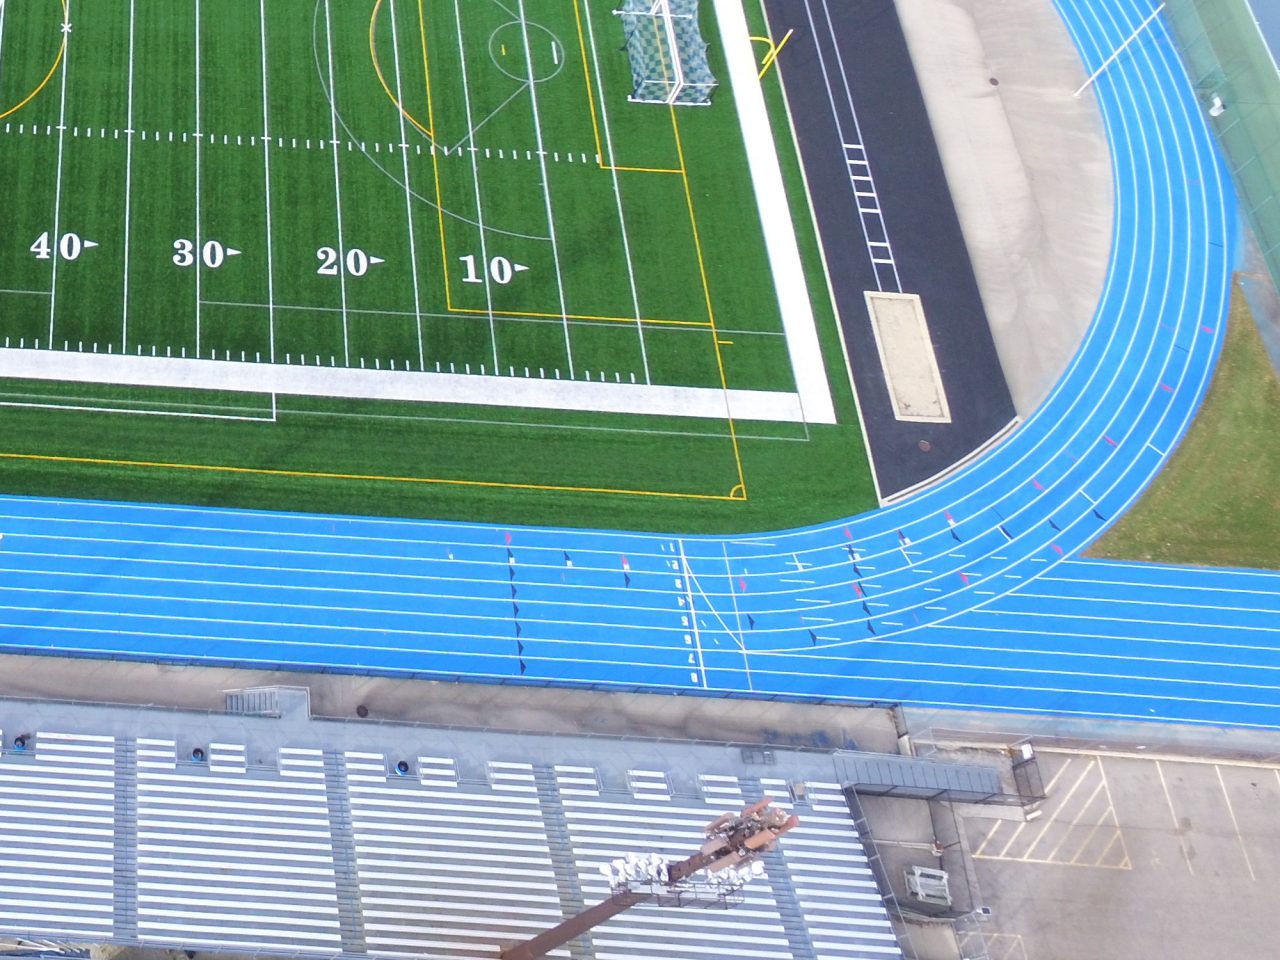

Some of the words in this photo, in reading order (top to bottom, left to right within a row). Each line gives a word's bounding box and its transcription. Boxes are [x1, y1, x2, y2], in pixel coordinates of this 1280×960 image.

[29, 231, 82, 261] 40
[172, 238, 225, 268] 30
[316, 246, 369, 276] 20
[459, 254, 512, 284] 10
